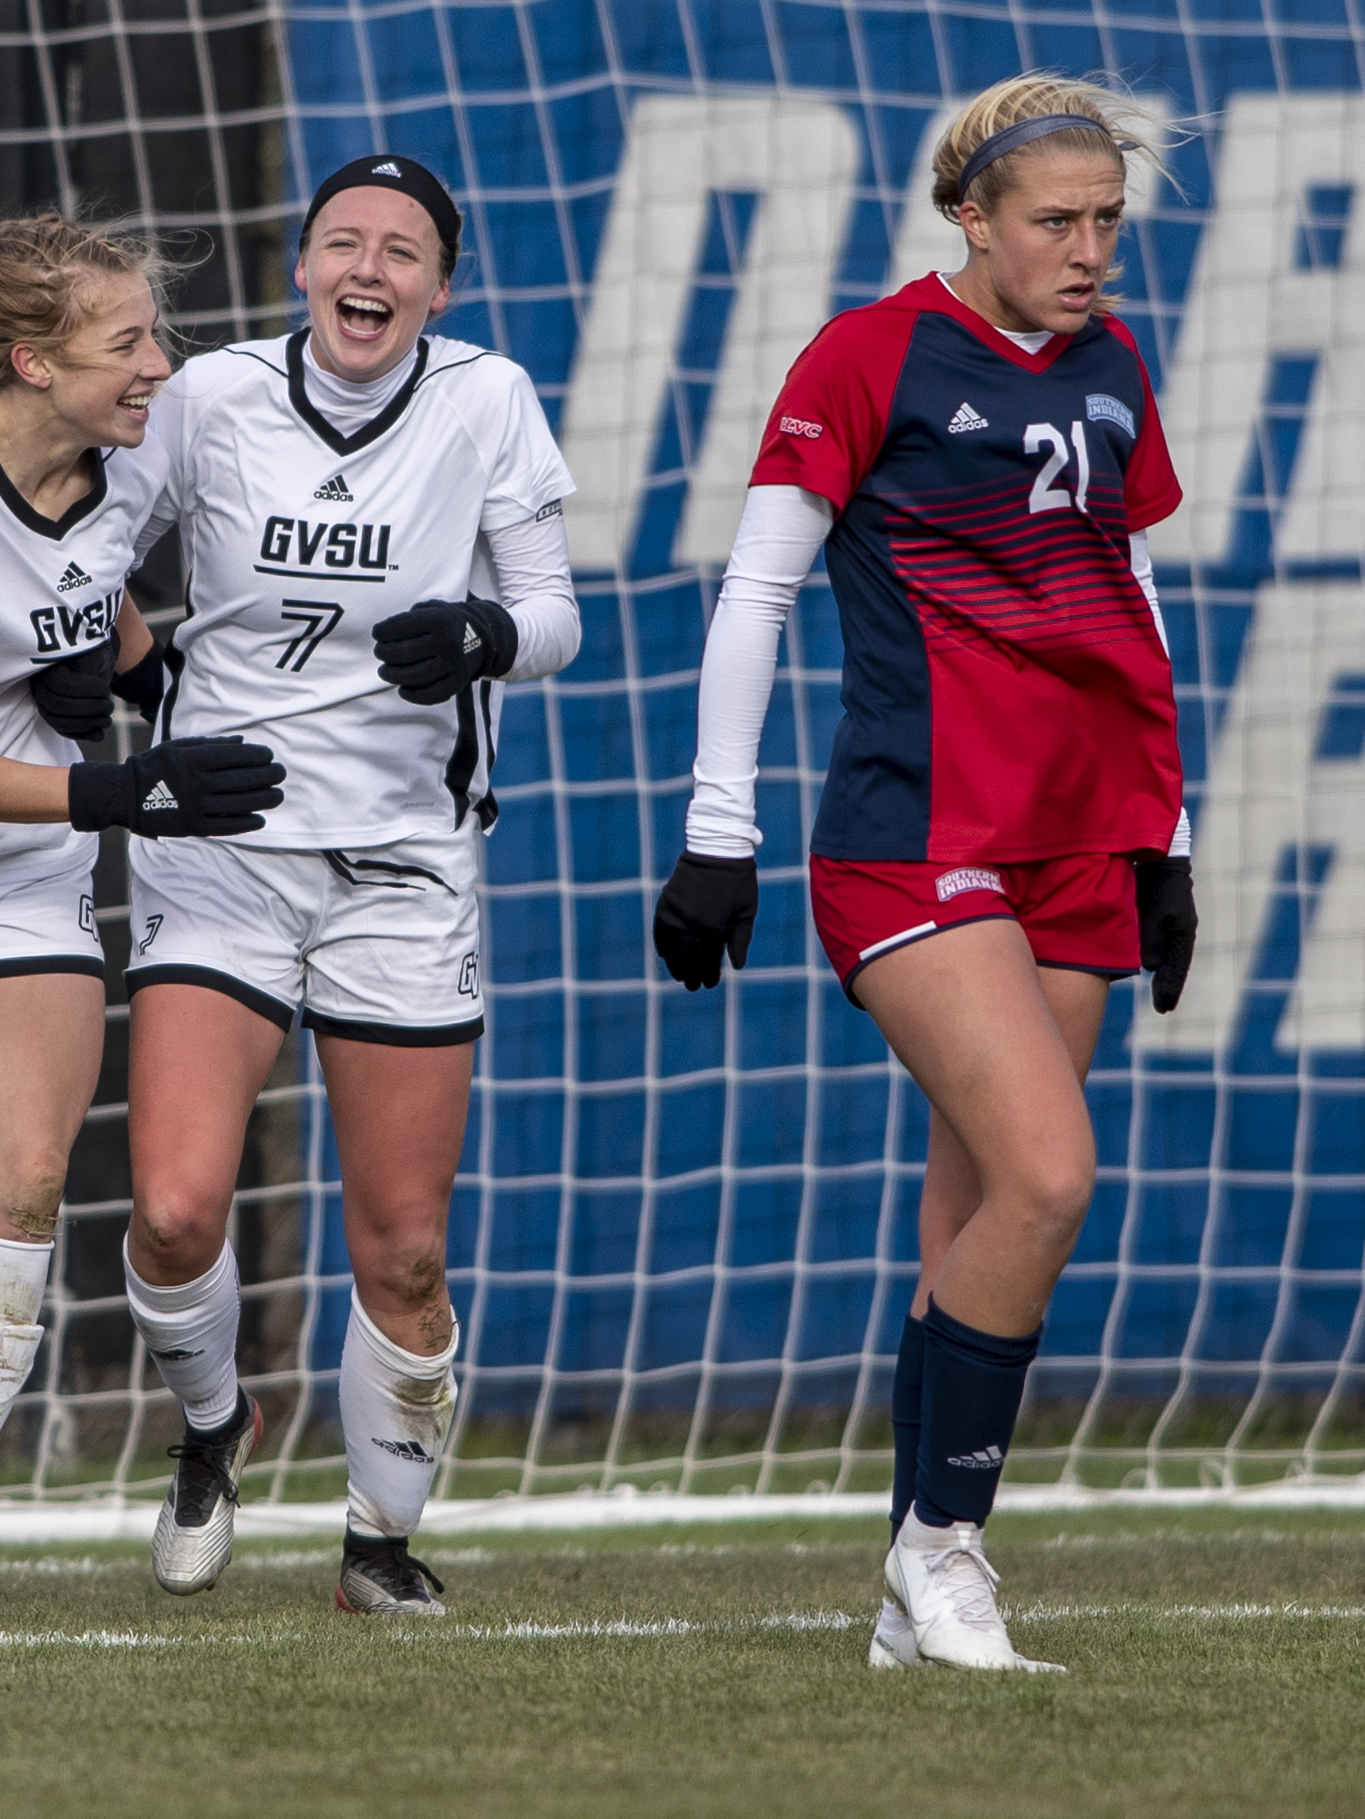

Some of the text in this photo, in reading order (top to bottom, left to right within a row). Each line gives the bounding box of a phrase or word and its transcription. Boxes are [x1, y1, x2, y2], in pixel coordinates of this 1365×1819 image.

[947, 417, 990, 434] adidas
[1024, 420, 1090, 514] 21
[313, 489, 354, 502] adidas
[260, 515, 392, 570] GVSU
[56, 575, 93, 593] adidas
[29, 586, 122, 653] GVSU
[275, 598, 345, 673] 7
[142, 799, 179, 811] adidas
[937, 869, 1001, 887] SOUTHERN
[939, 878, 1006, 898] INDIANA
[139, 914, 165, 957] 7
[371, 1437, 435, 1463] adidas
